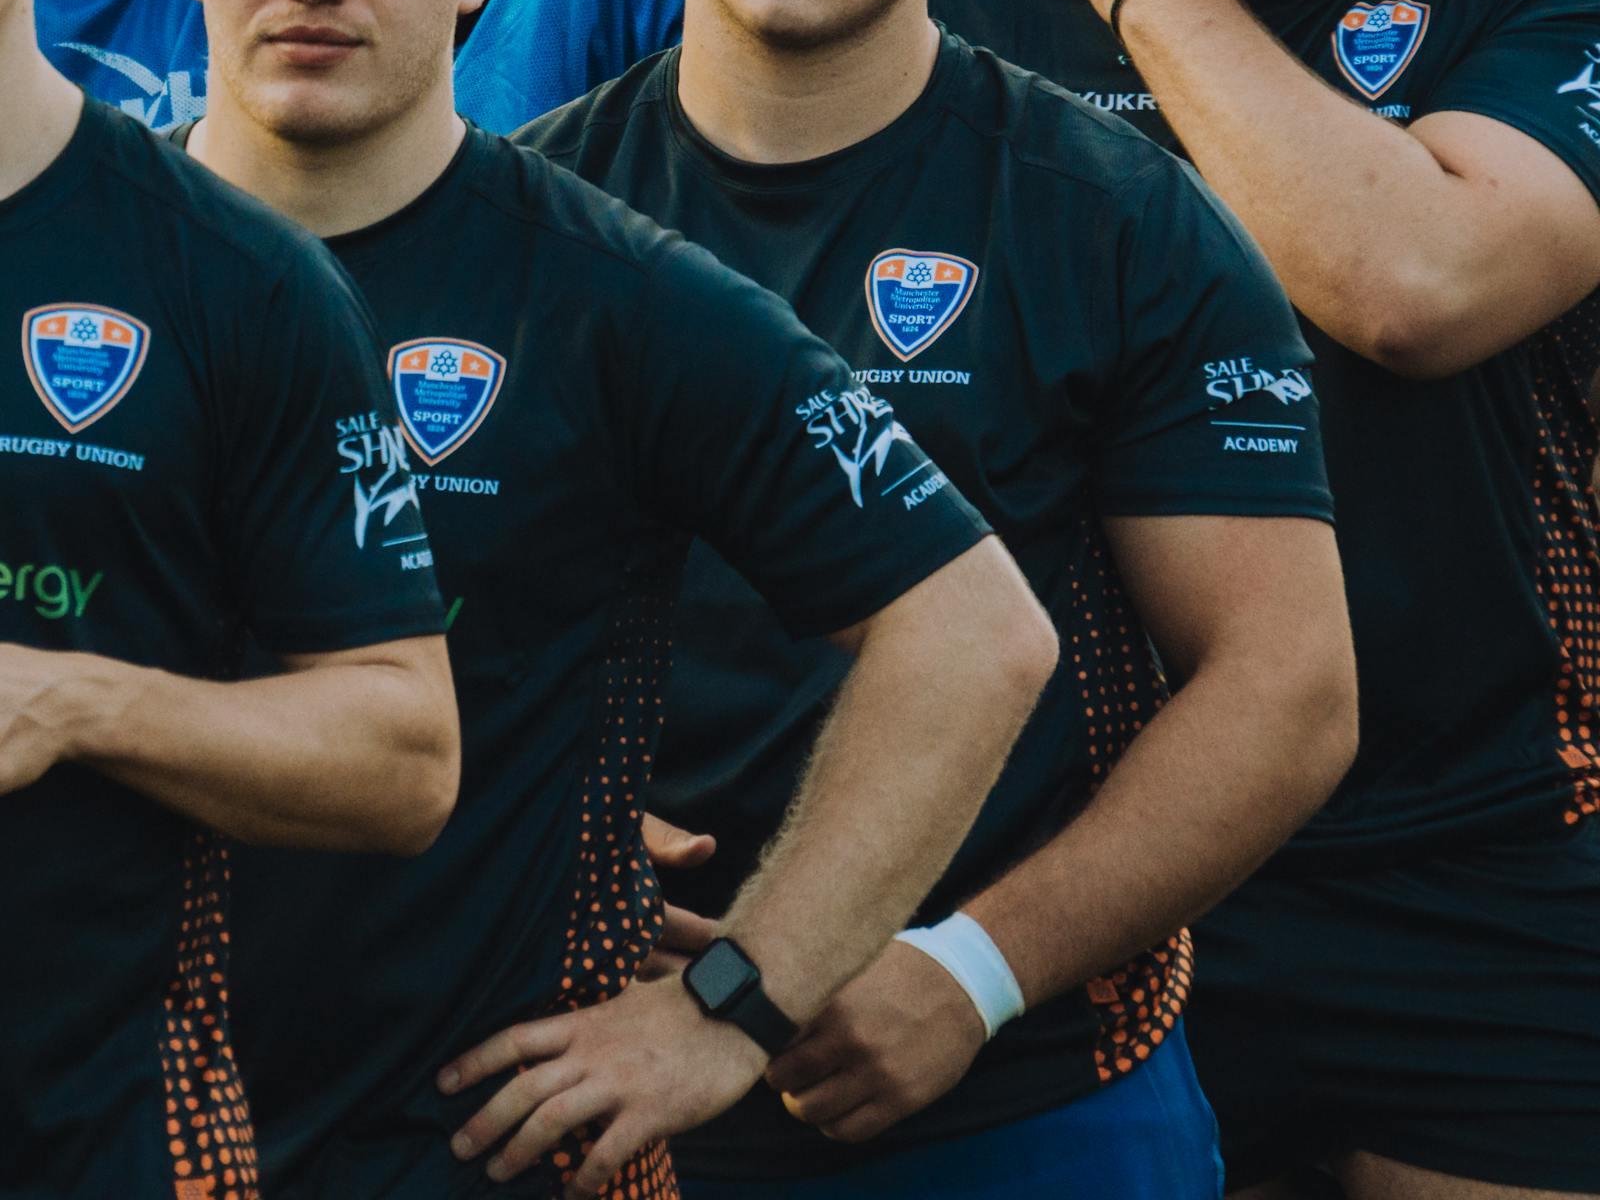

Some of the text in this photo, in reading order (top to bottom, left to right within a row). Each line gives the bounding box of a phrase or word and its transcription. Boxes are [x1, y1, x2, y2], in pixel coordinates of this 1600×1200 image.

[1353, 54, 1398, 65] SPORT
[1073, 91, 1157, 111] UKR
[891, 294, 941, 305] Metropolitan
[894, 287, 940, 297] Manchester
[894, 302, 935, 312] University
[888, 314, 936, 325] SPORT
[1204, 357, 1254, 379] SALE
[52, 376, 106, 393] SPORT
[850, 369, 971, 385] UGBY UNION
[414, 388, 467, 400] Metropolitan
[418, 381, 466, 392] Manchester
[418, 397, 461, 409] University
[795, 389, 837, 421] SALE
[336, 411, 379, 438] SALE
[413, 411, 462, 425] SPORT
[1223, 436, 1299, 454] ACADEMY
[75, 444, 146, 471] UNION
[434, 476, 500, 495] UNION
